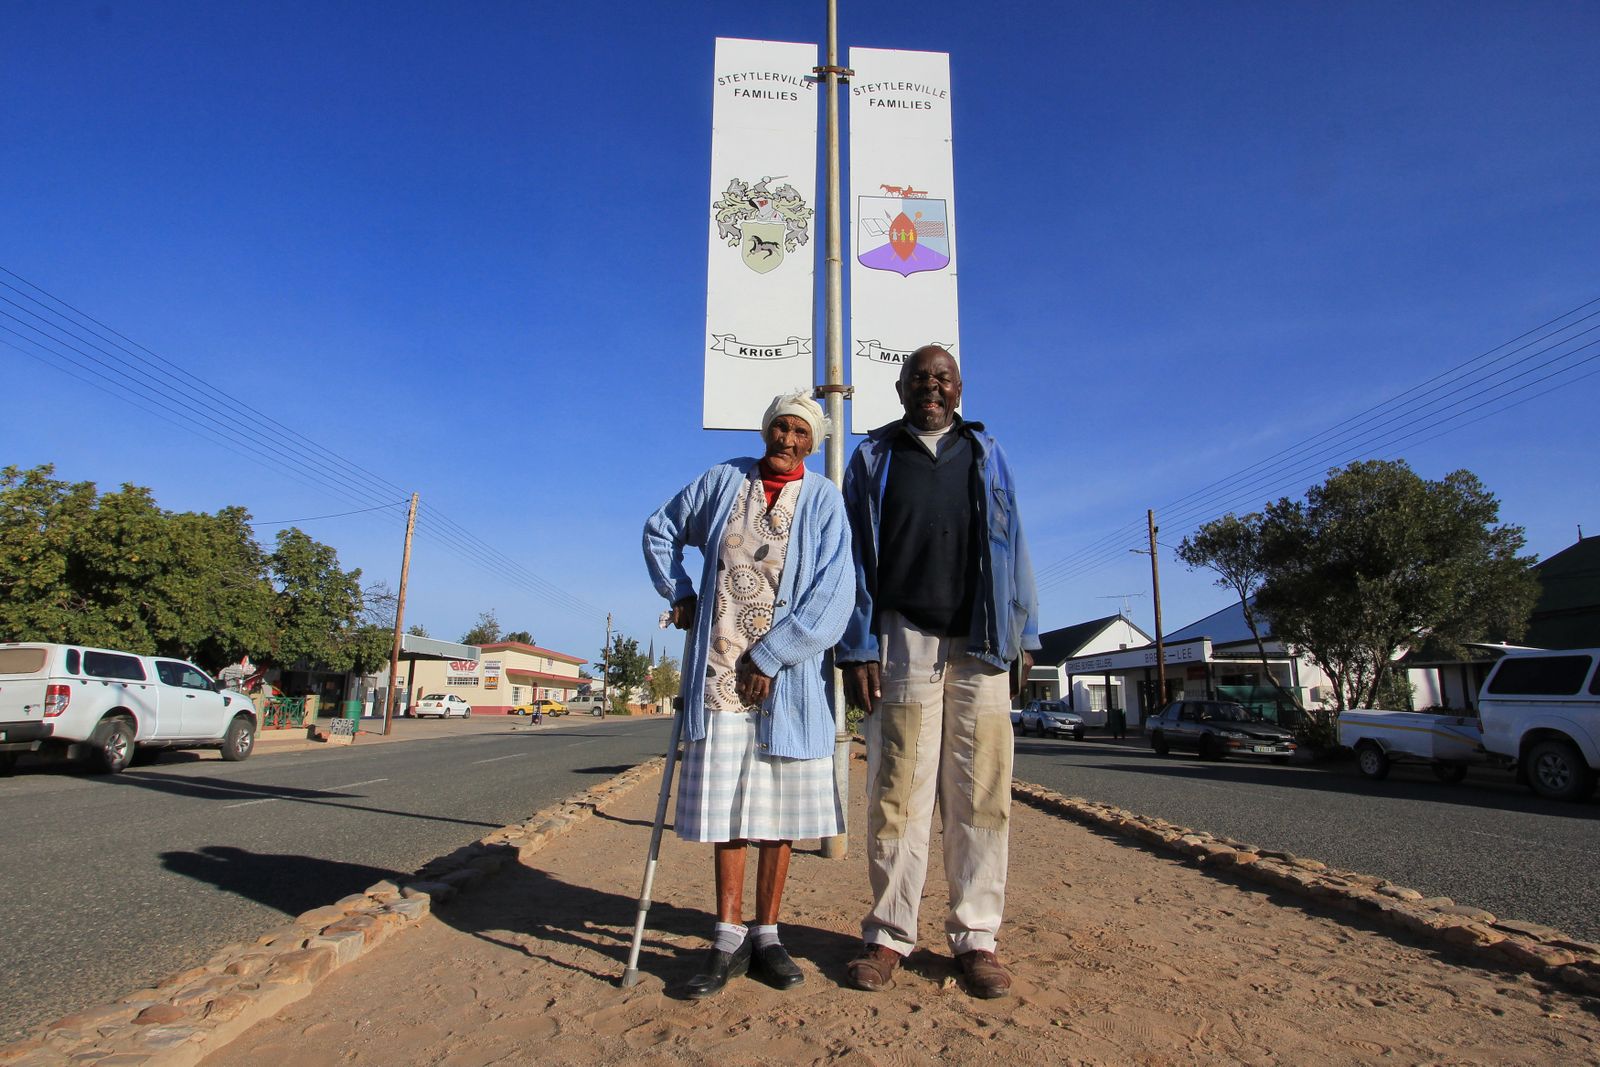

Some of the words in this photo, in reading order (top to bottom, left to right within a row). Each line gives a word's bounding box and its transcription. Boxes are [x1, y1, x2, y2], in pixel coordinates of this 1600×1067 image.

[718, 72, 814, 91] STEYTLERVILLE
[734, 88, 798, 101] FAMILIES
[853, 81, 947, 99] STEYTLERVILLE
[869, 98, 932, 110] FAMILIES
[739, 347, 783, 357] KRIGE
[449, 661, 479, 671] BKB
